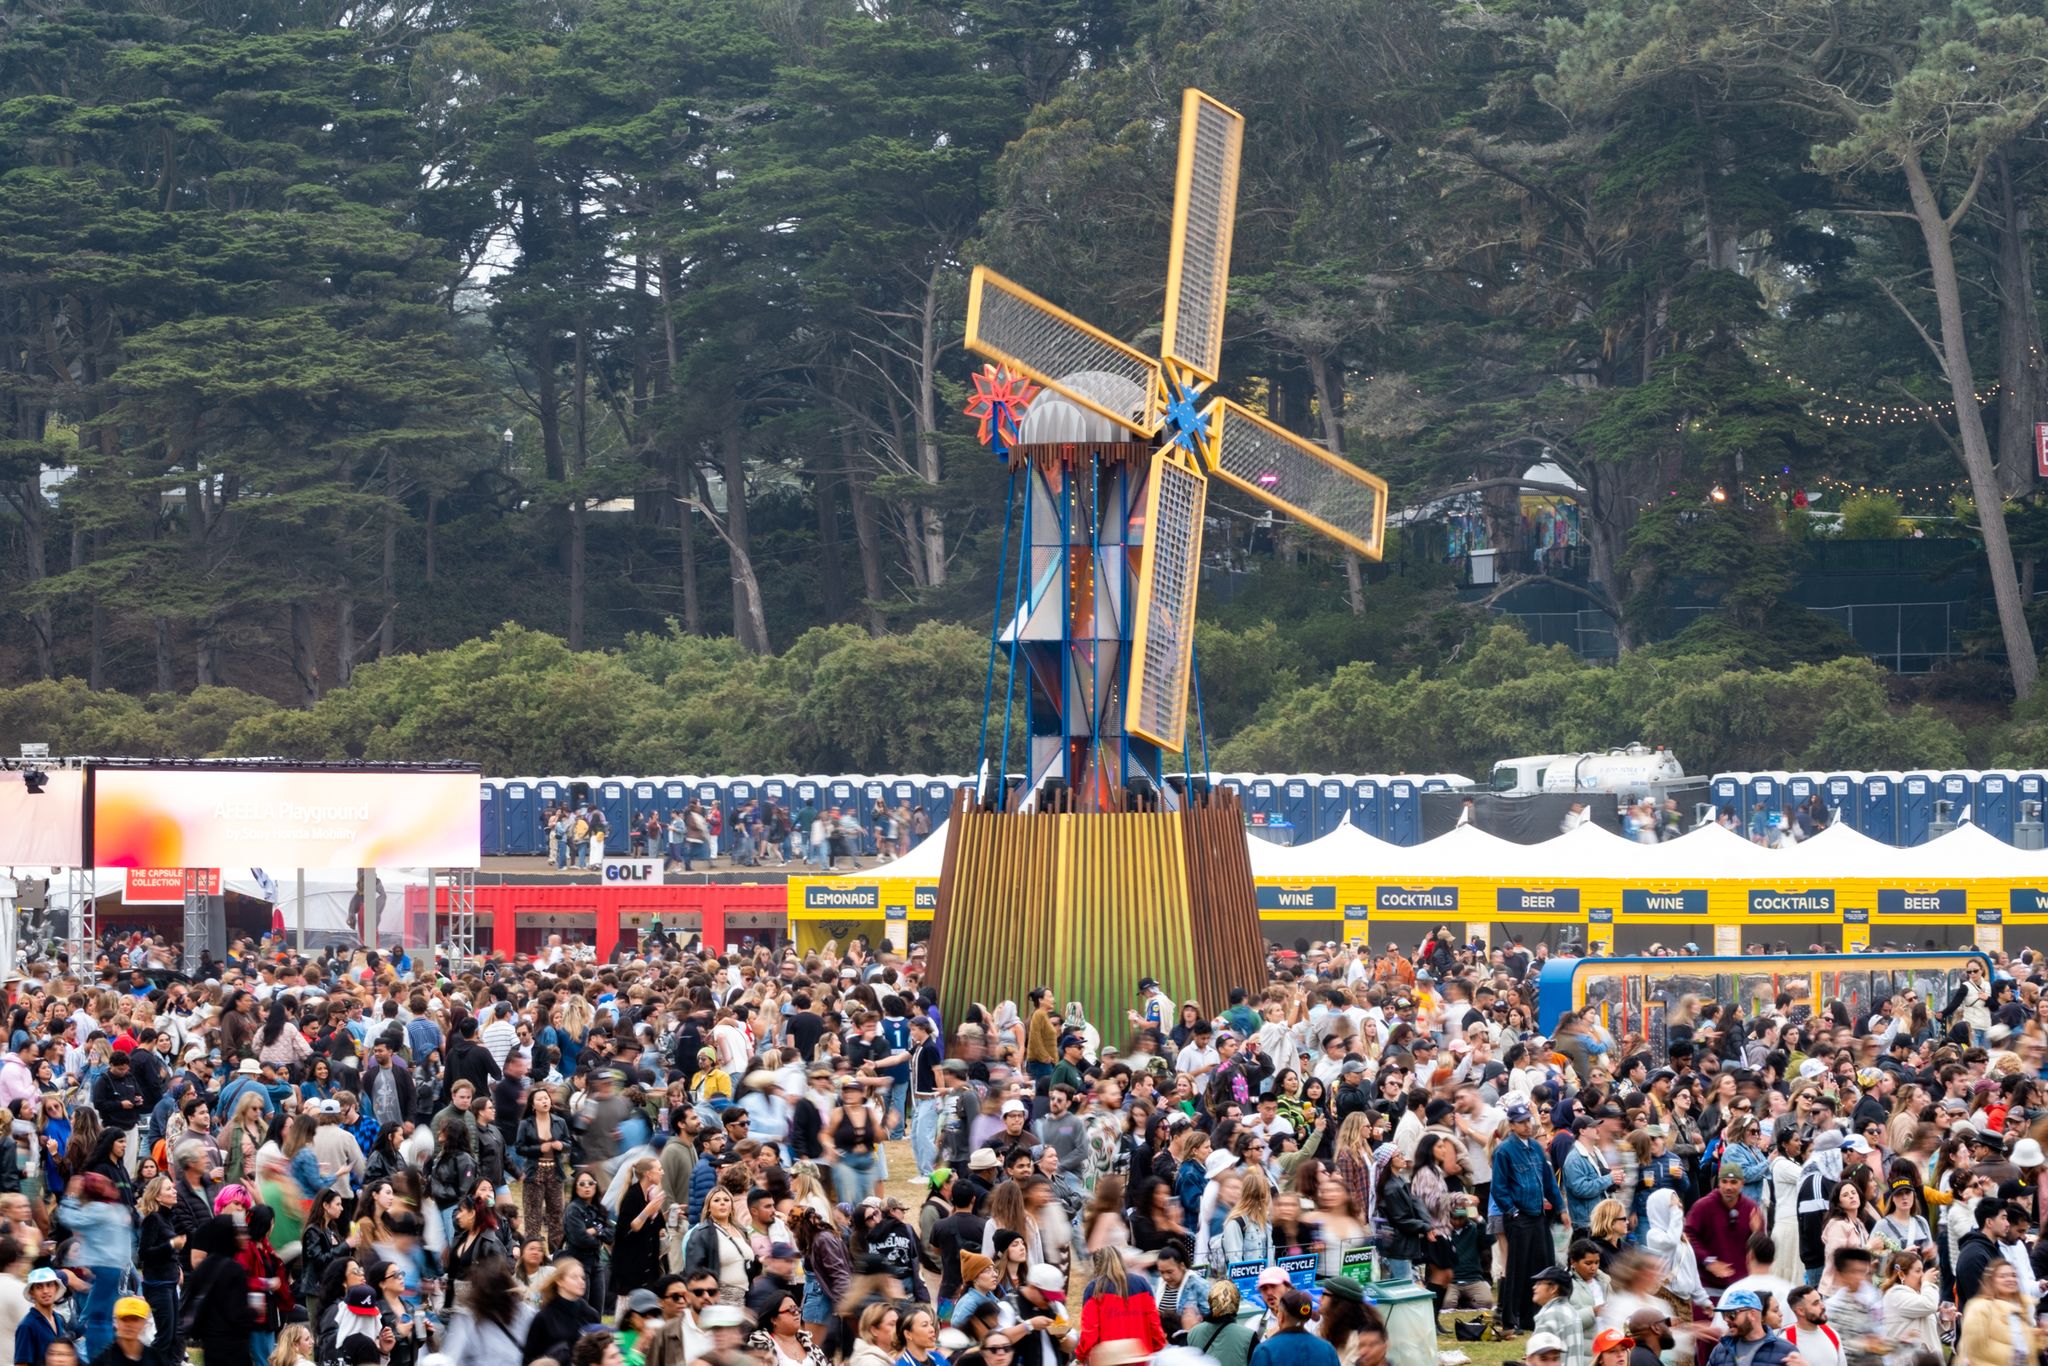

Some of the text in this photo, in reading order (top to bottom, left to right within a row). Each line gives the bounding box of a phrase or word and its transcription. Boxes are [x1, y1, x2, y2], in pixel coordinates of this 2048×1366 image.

[279, 801, 369, 824] Playground
[148, 870, 183, 878] CAPSULE
[606, 865, 652, 880] GOLF
[132, 878, 180, 886] COLLECTION
[809, 893, 875, 905] LEMONADE
[1278, 894, 1314, 906] WINE
[1381, 895, 1453, 906] COCKTAILS
[1521, 896, 1555, 908] BEER
[1646, 897, 1684, 909] WINE
[1753, 897, 1830, 910] COCKTAILS
[1904, 898, 1940, 910] BEER
[894, 1030, 901, 1047] 1
[1345, 1251, 1372, 1263] COMPOST
[1231, 1265, 1265, 1277] RECYCLE
[1280, 1259, 1315, 1271] RECYCLE
